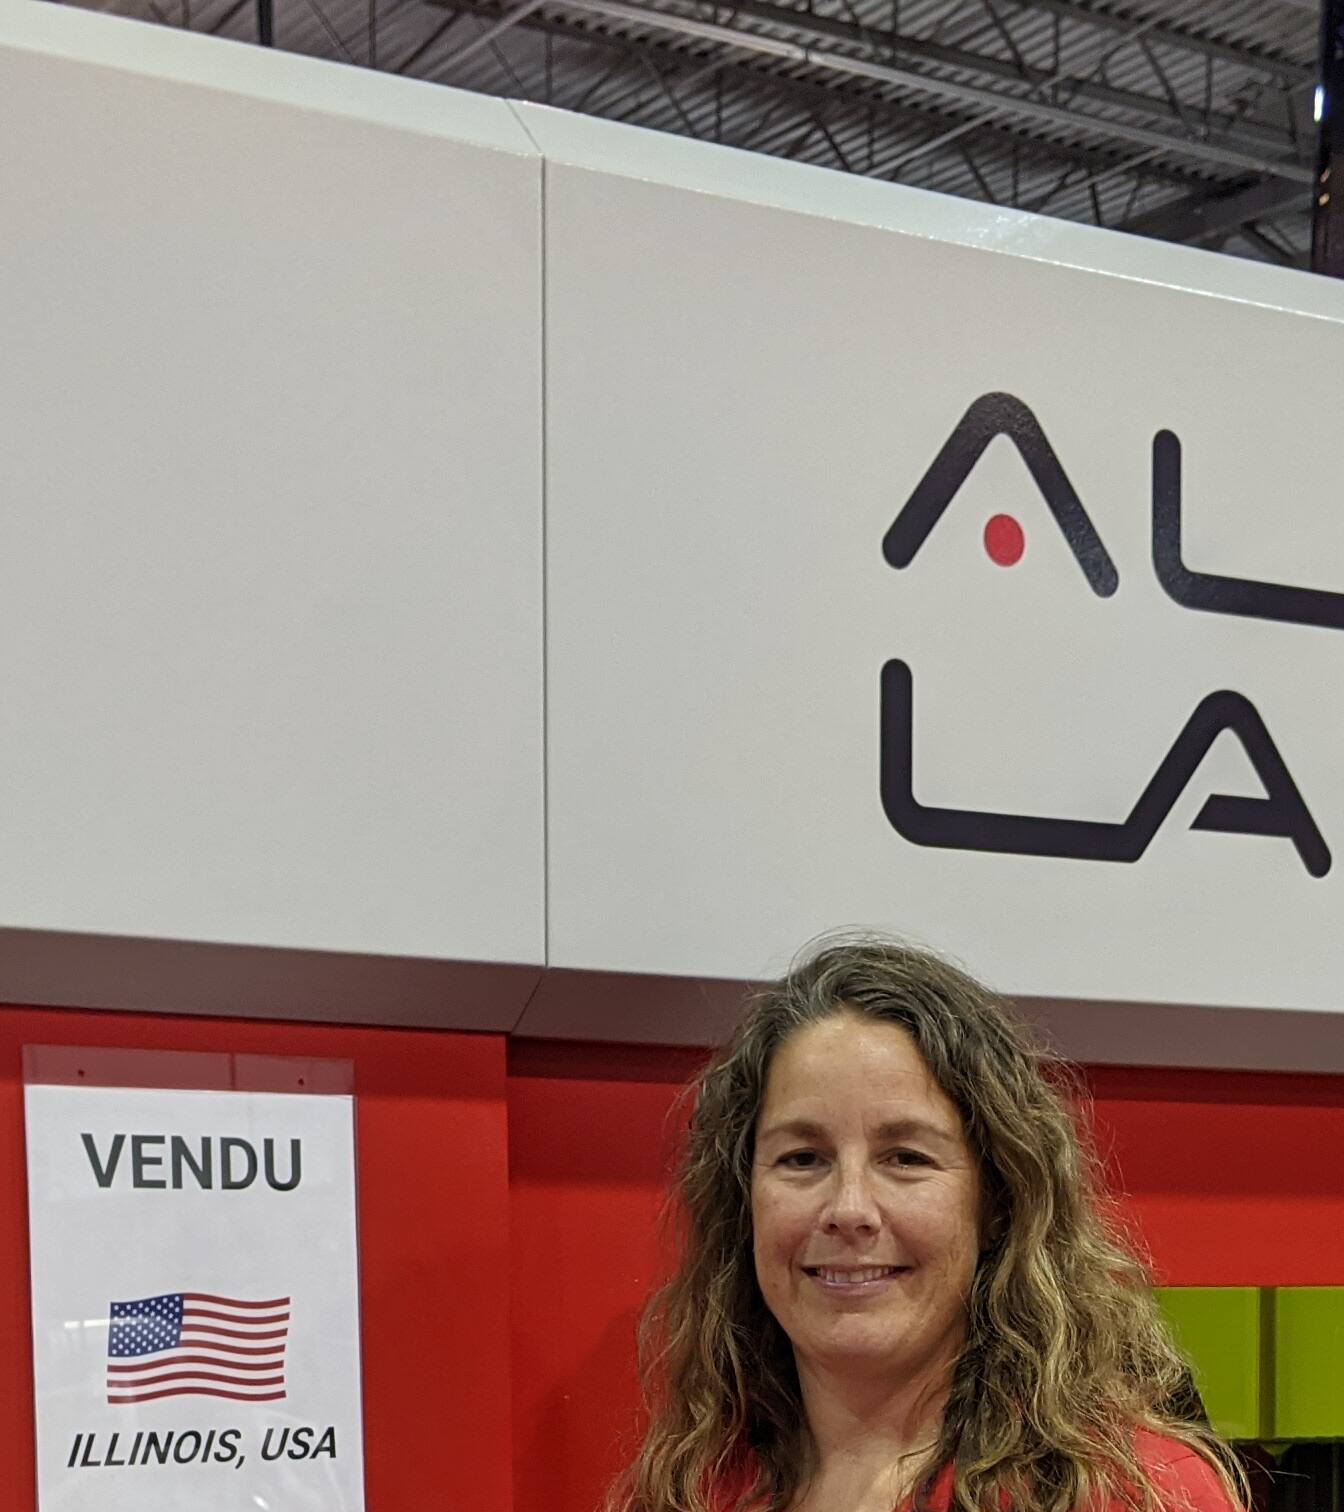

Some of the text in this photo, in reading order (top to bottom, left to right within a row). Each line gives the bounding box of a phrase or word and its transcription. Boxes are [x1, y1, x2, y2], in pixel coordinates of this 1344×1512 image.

[81, 1132, 303, 1192] VENDU
[67, 1426, 337, 1469] ILLINOIS, USA
